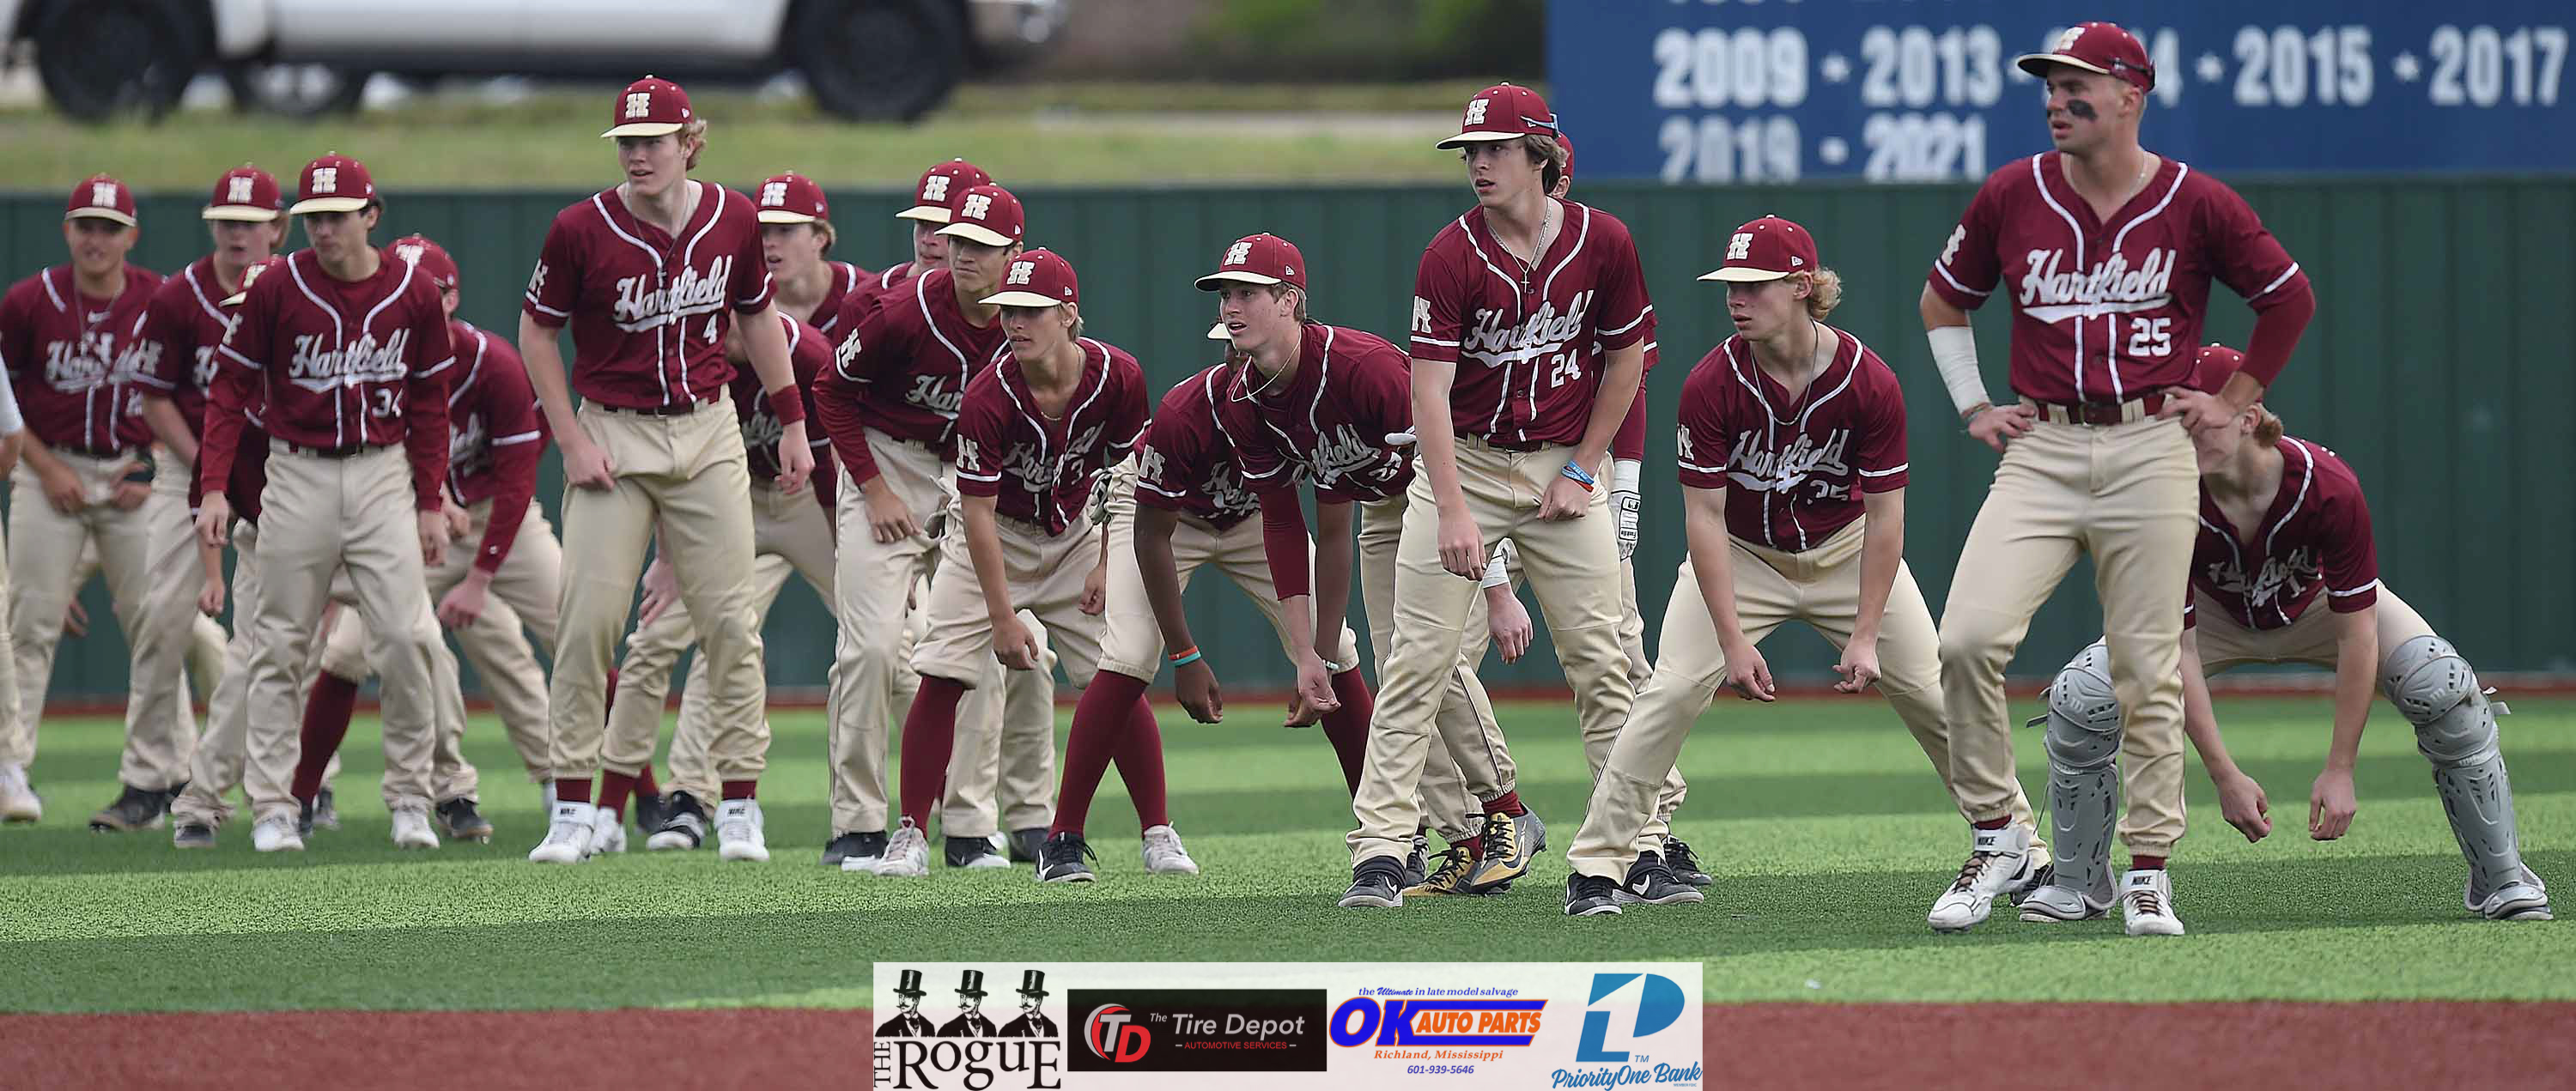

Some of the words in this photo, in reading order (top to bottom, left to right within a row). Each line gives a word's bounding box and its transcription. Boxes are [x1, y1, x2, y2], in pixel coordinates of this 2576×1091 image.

[1654, 27, 1807, 108] 2009
[1861, 26, 2002, 106] 2013
[2234, 26, 2373, 106] 2015
[2429, 26, 2567, 106] 2017
[625, 93, 650, 118] H
[1464, 99, 1490, 126] H
[1863, 112, 1987, 182] 2021
[228, 176, 253, 203] H
[312, 167, 337, 193] H
[762, 182, 787, 207] H
[924, 174, 951, 203] H
[961, 193, 993, 221] H
[1224, 241, 1253, 266] H
[1726, 233, 1754, 260] H
[1006, 260, 1035, 286] H
[2020, 247, 2177, 321] Hartfield
[613, 255, 732, 332] Hartfield
[702, 312, 718, 345] 4
[1412, 295, 1432, 334] H
[2128, 317, 2172, 357] 25
[289, 328, 410, 391] Hartfield
[1551, 348, 1582, 389] 24
[957, 433, 981, 472] H
[1139, 444, 1166, 484] H
[1728, 428, 1849, 494] Hartfield
